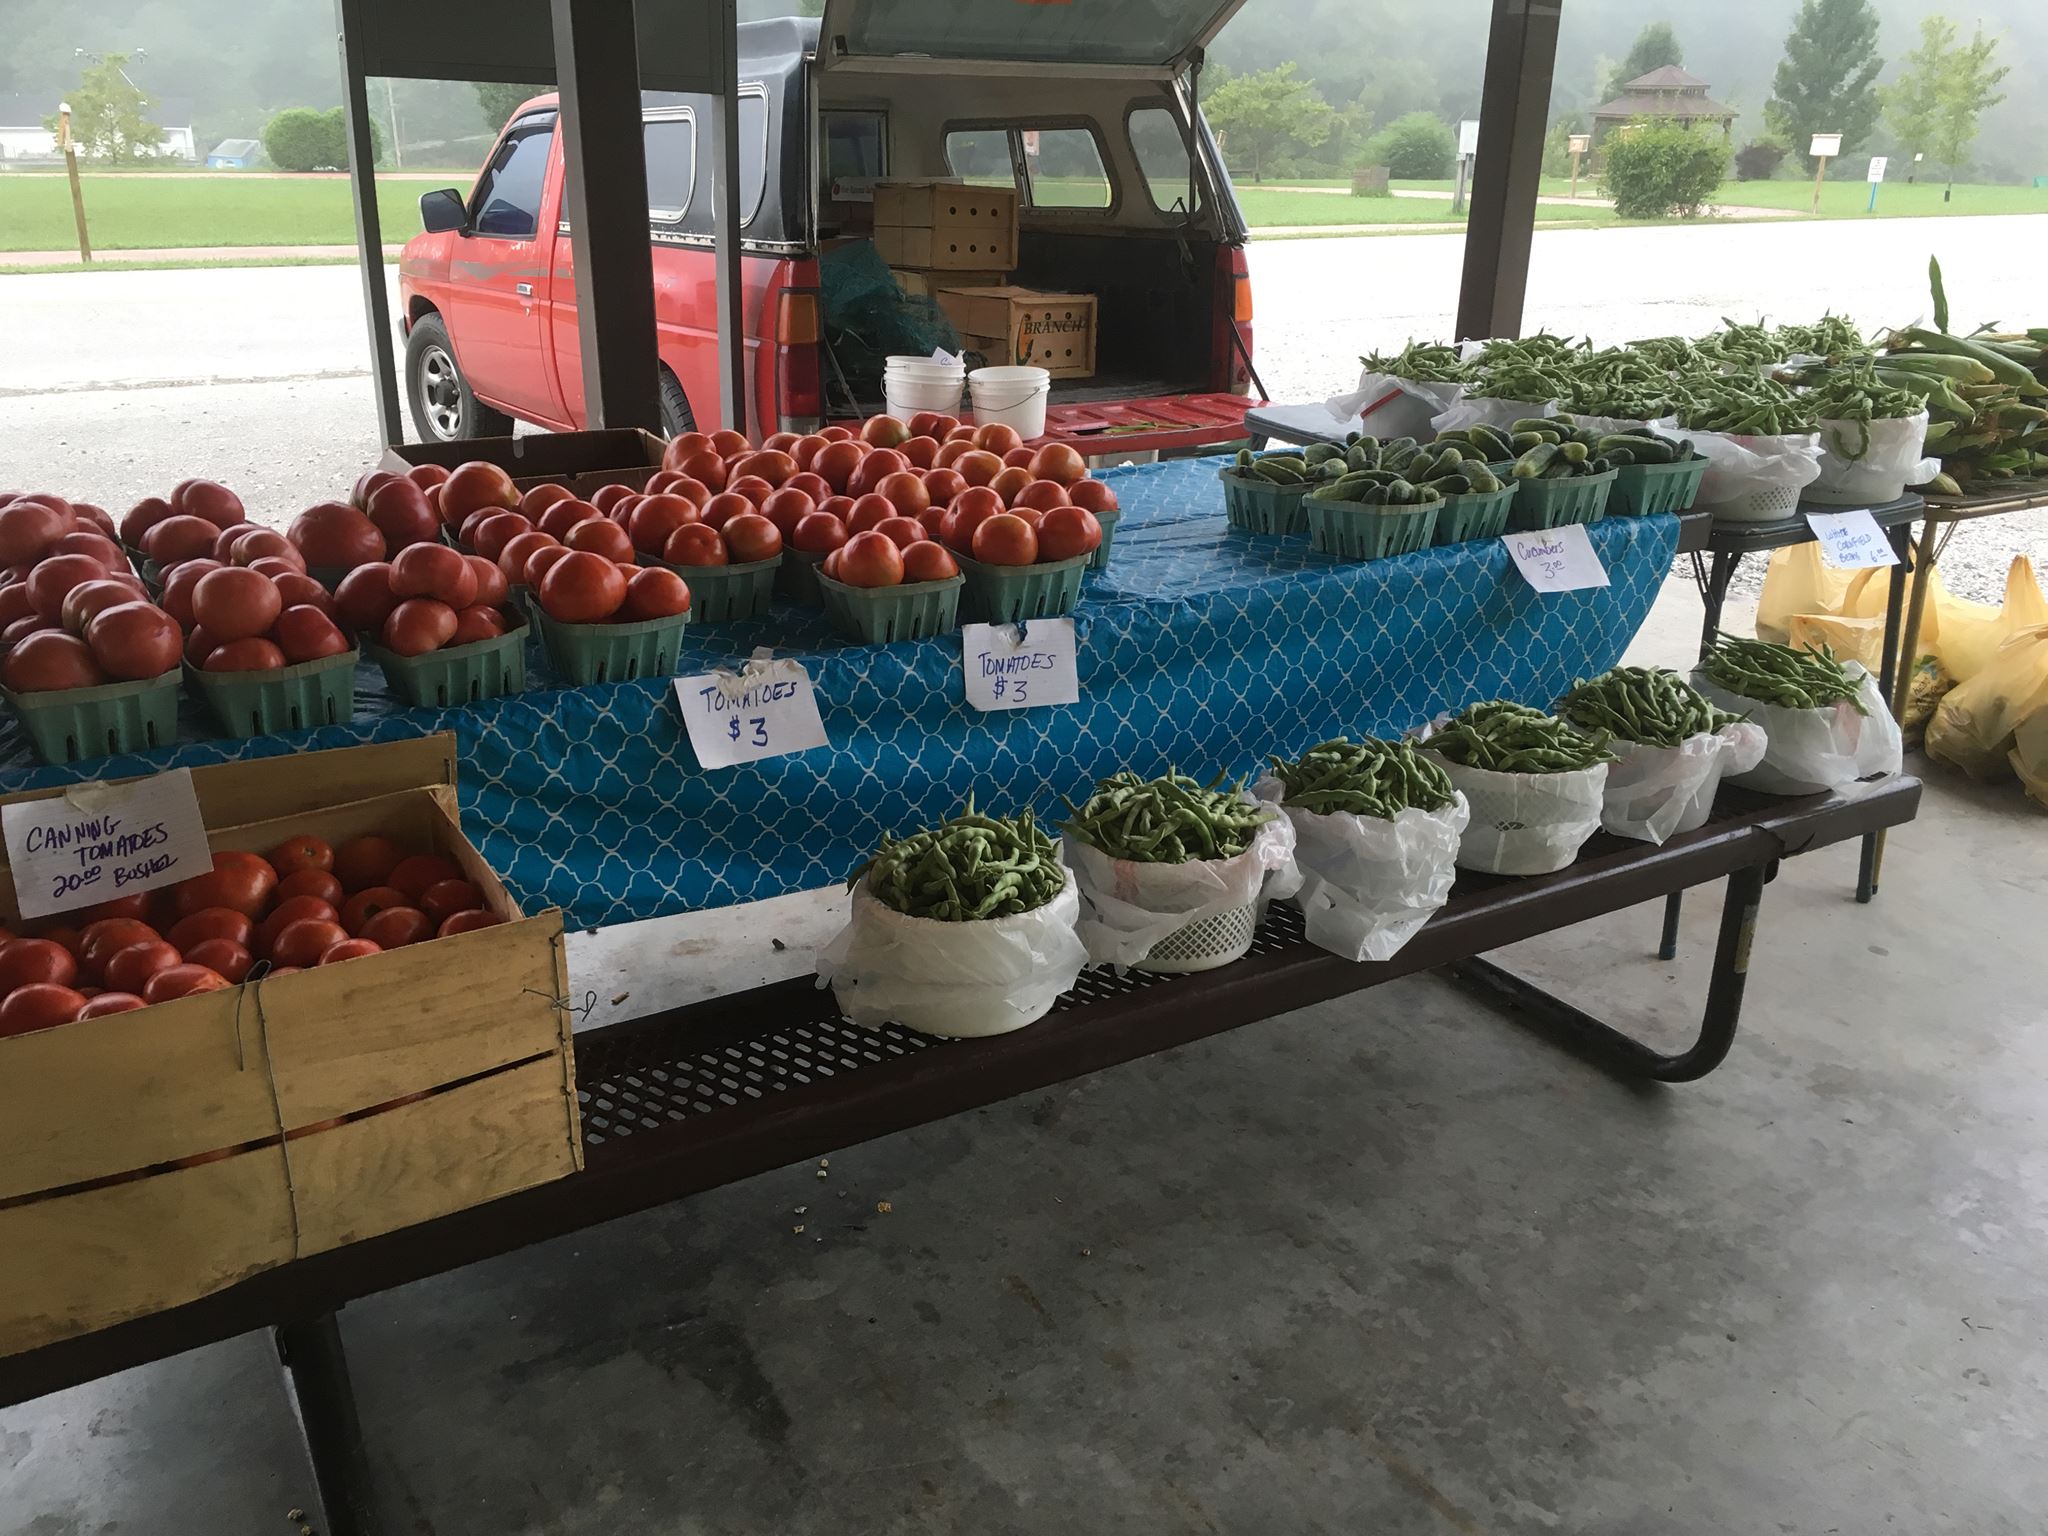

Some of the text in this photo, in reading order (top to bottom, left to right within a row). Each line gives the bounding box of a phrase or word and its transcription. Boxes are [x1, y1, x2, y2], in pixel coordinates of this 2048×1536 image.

[1024, 320, 1083, 335] BRANCH
[976, 651, 1057, 678] TOMATOES
[26, 815, 121, 853] CANNING
[73, 822, 168, 867] TOMATOES
